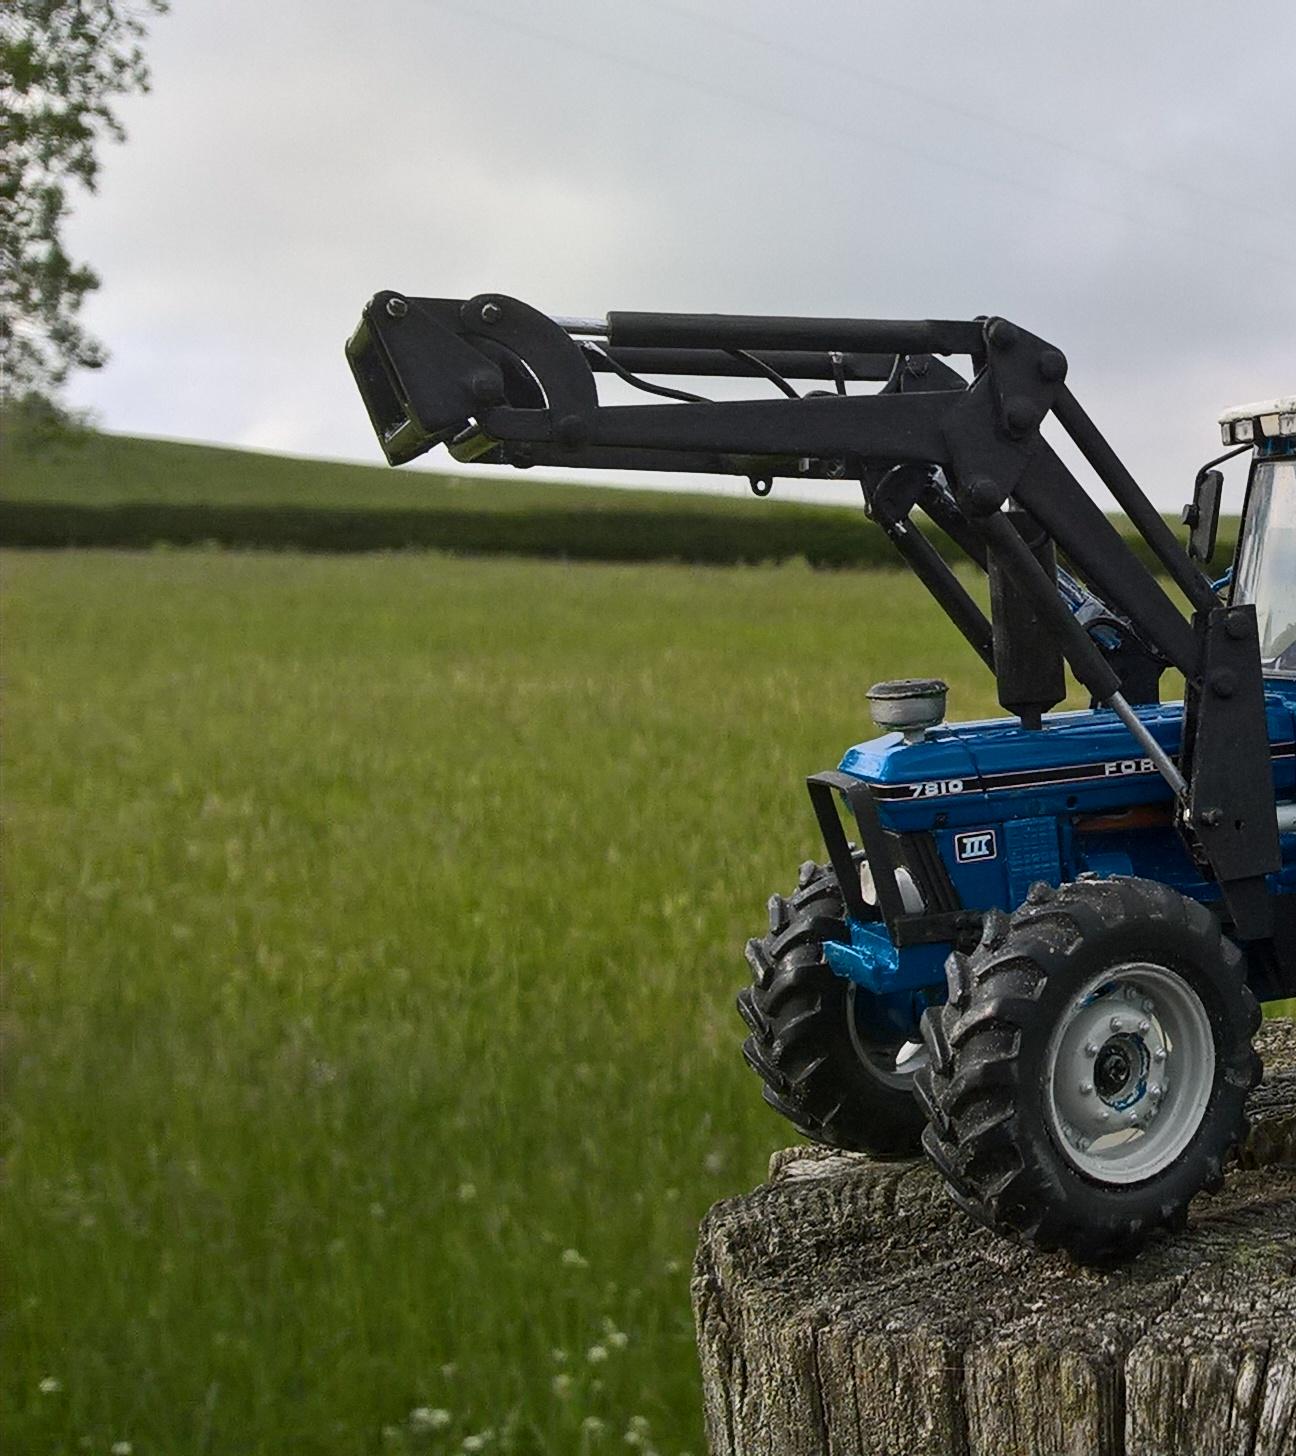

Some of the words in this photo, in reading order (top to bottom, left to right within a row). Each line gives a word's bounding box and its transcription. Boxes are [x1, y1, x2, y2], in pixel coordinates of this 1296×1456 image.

[1104, 758, 1155, 776] FOR
[909, 780, 963, 799] 7810
[961, 834, 991, 858] III
